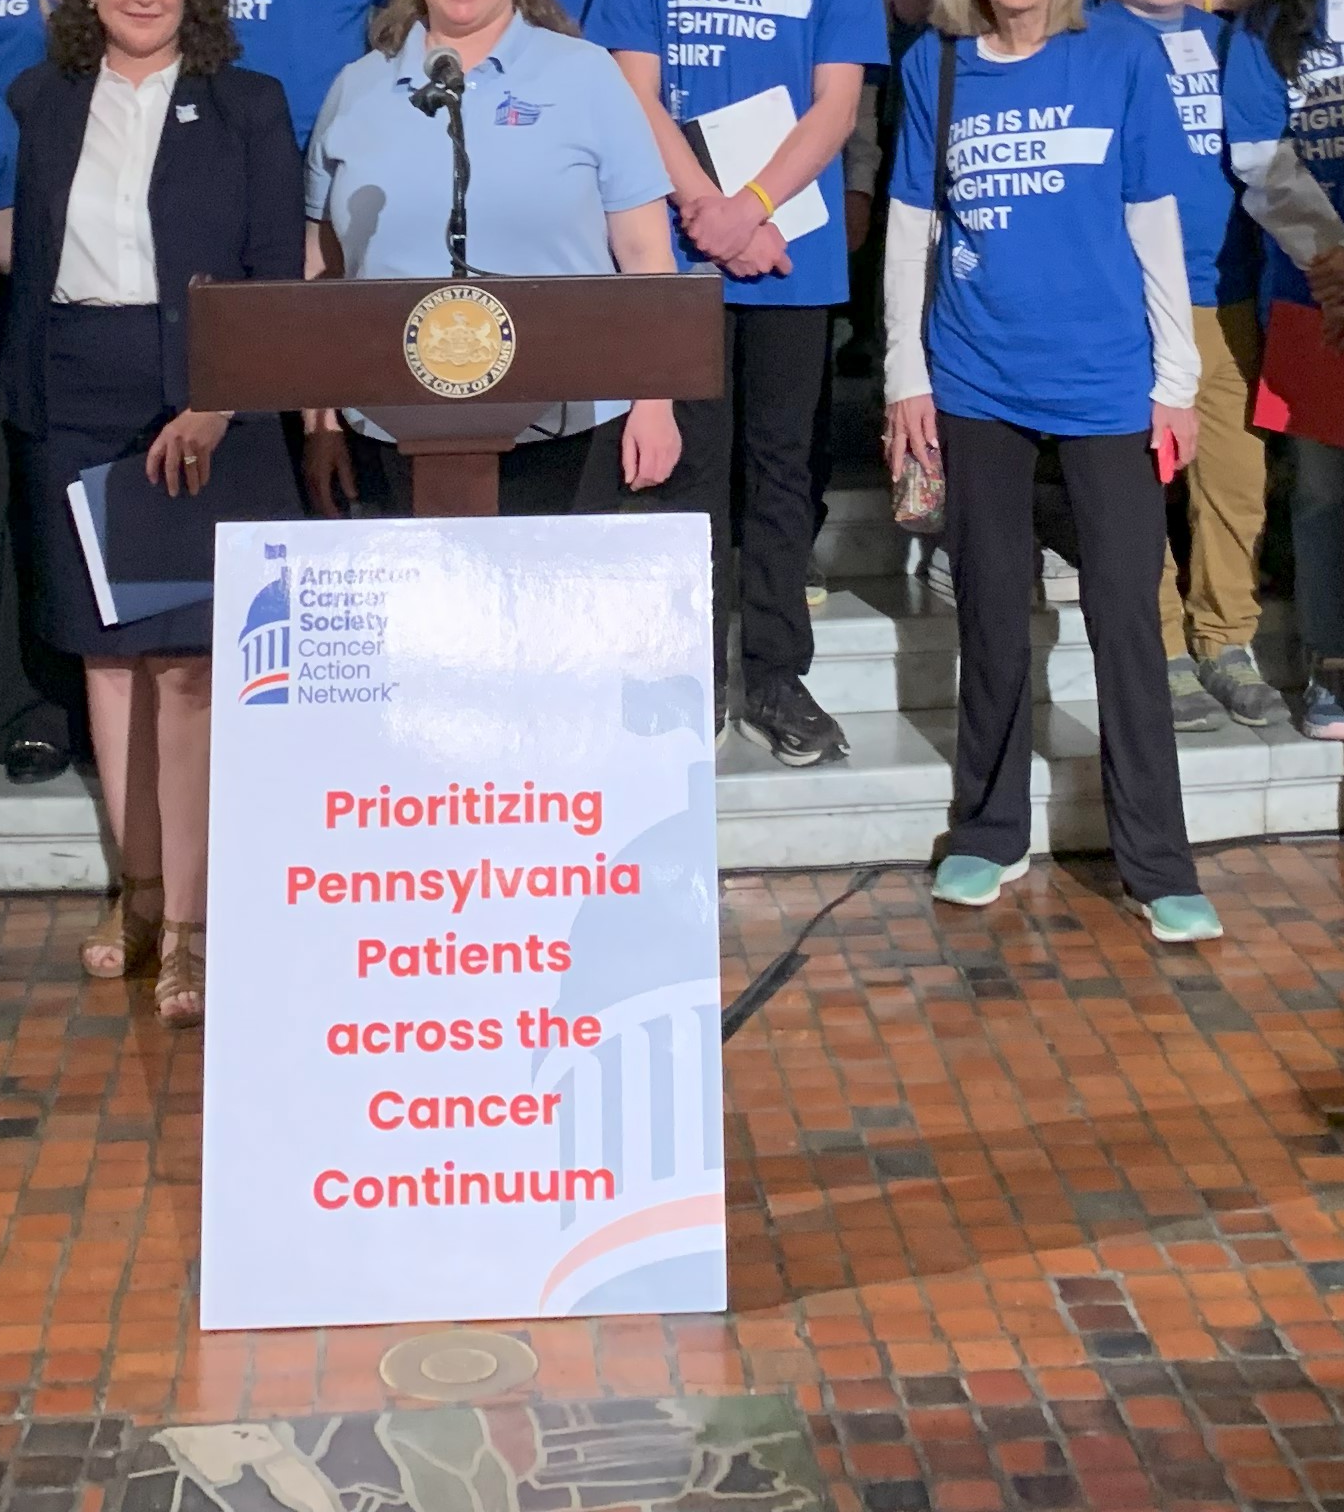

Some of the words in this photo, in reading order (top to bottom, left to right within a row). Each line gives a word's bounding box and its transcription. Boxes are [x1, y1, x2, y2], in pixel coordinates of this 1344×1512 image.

[667, 11, 777, 42] FGHTING
[1186, 72, 1219, 95] MY
[996, 107, 1024, 132] IS
[1028, 103, 1075, 130] MY
[410, 288, 508, 327] PENNSYLVANIA
[406, 342, 435, 384] STATE
[432, 379, 471, 395] COAT
[471, 374, 491, 392] OF
[490, 340, 512, 380] ARMS
[299, 566, 421, 586] American
[299, 589, 388, 608] Cancer
[299, 609, 389, 637] Society
[298, 638, 385, 657] Cancer
[297, 660, 371, 681] Action
[297, 682, 393, 705] Network
[326, 780, 603, 836] Prioritizing
[286, 852, 641, 914] Pennsylvania
[357, 931, 572, 979] Patients
[327, 1018, 504, 1055] across
[516, 1007, 602, 1048] the
[368, 1089, 562, 1130] Cancer
[313, 1160, 615, 1211] Continuum
